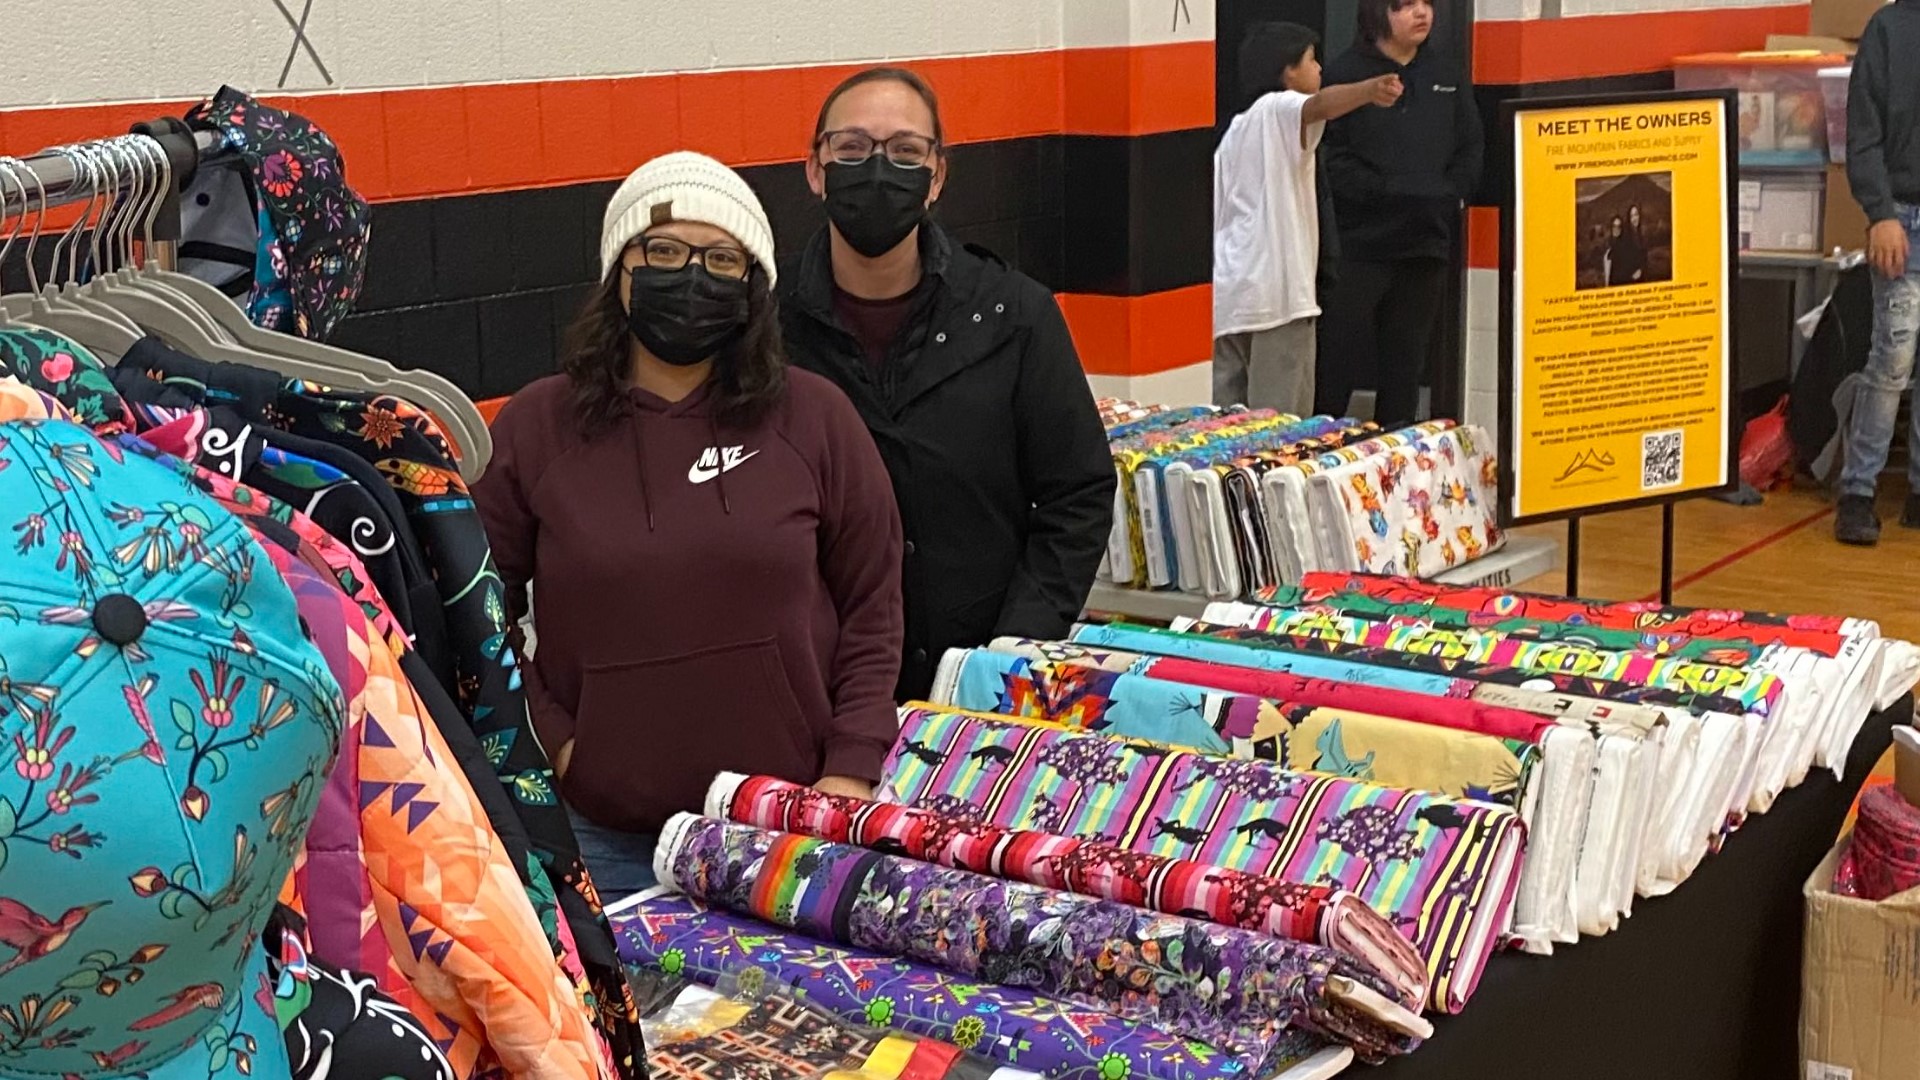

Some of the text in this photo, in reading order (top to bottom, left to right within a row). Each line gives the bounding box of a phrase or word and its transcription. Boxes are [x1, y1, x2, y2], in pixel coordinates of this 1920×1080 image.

[1538, 111, 1712, 137] MEET THE OWNERS
[1545, 133, 1702, 156] FIRE MOUNTAIN FABRICS AND SUPPLY
[699, 445, 744, 467] NIKE
